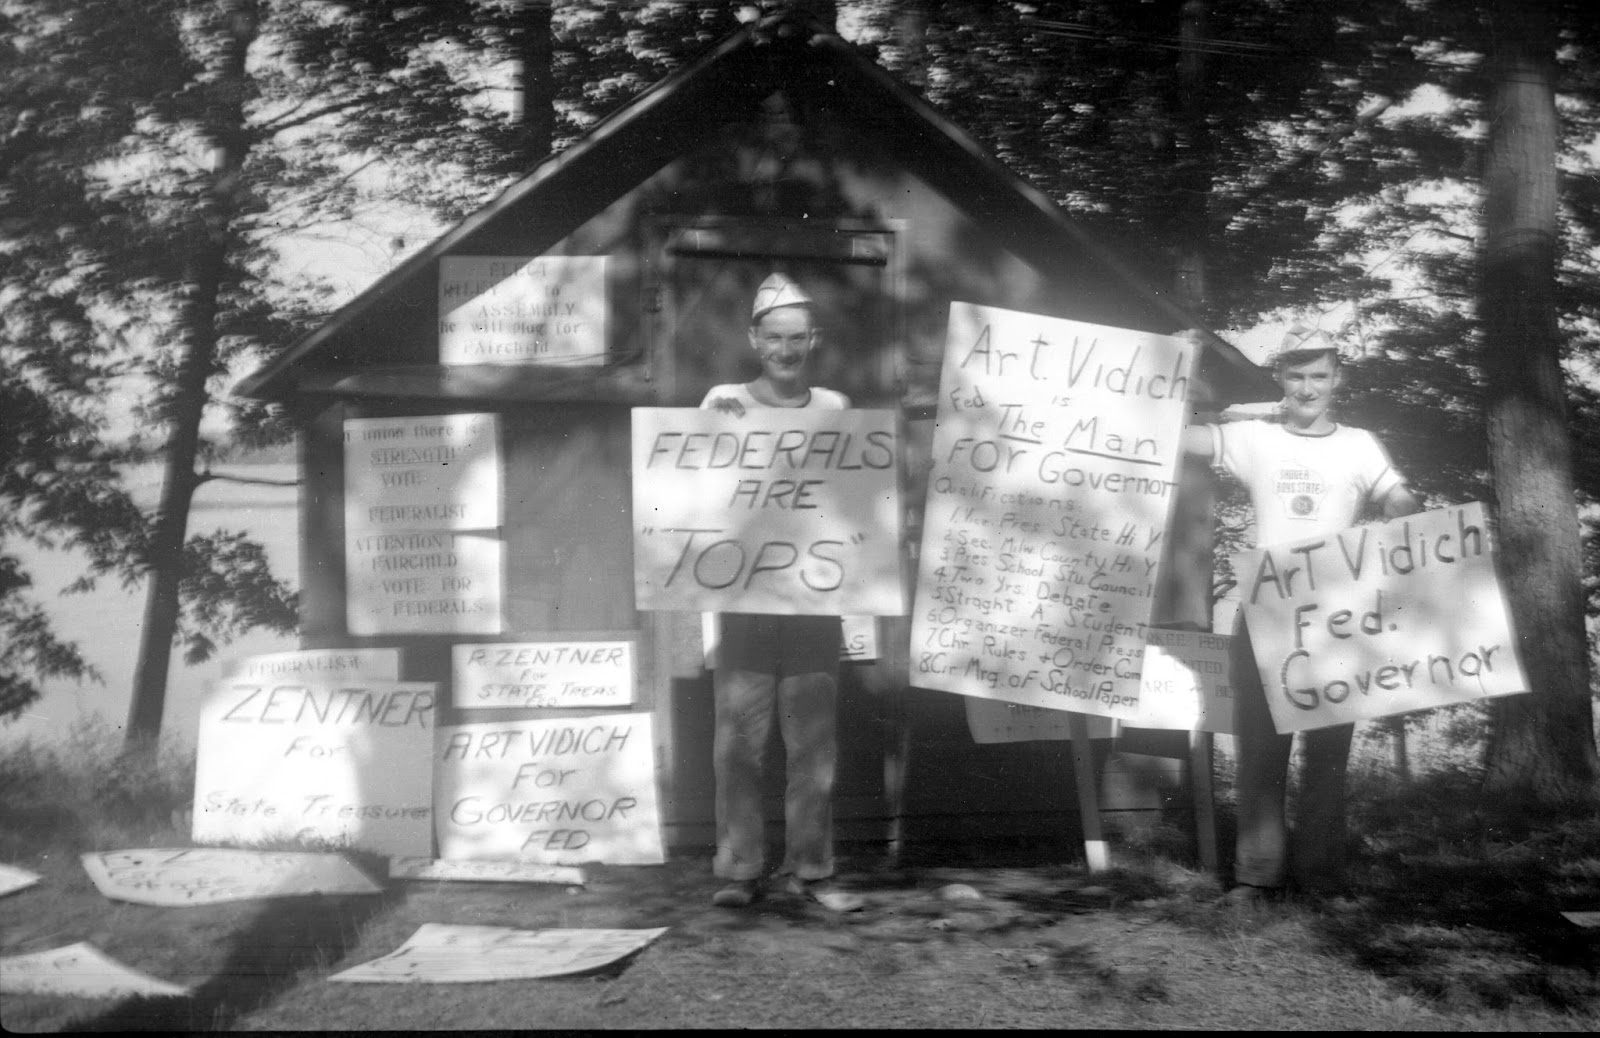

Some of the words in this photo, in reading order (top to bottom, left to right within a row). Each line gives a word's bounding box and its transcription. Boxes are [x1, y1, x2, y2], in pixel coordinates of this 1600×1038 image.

[1067, 335, 1188, 401] Vidich
[951, 384, 984, 409] Fed
[998, 403, 1046, 438] The
[1063, 415, 1158, 456] Man
[647, 430, 894, 471] FEDERALS
[380, 470, 423, 487] VOTE
[1038, 451, 1179, 499] Governor
[1297, 482, 1320, 495] STATE
[729, 479, 825, 510] ARE
[1052, 516, 1110, 541] State
[1115, 522, 1136, 546] Hi
[1144, 526, 1162, 552] Y
[1337, 508, 1483, 583] Vidich
[372, 553, 458, 571] FAIRCHILD
[954, 546, 989, 567] Pres
[995, 553, 1045, 578] School
[1040, 541, 1108, 574] County
[1145, 556, 1158, 577] Y
[382, 577, 426, 595] VOTE
[441, 576, 472, 592] FOR
[951, 565, 984, 585] Two
[1037, 581, 1111, 613] Debate
[939, 606, 1028, 636] Organizer
[1034, 623, 1092, 651] Federal
[1098, 634, 1143, 659] Press
[1064, 606, 1148, 639] Student
[1295, 588, 1398, 648] Fed.
[496, 647, 625, 668] ZENTNER
[982, 635, 1027, 661] Rules
[1053, 647, 1112, 676] Order
[477, 682, 550, 700] STATE
[1040, 668, 1096, 700] School
[1096, 680, 1139, 711] Paper
[1280, 643, 1501, 712] Governor
[221, 684, 434, 728] ZENTNER
[284, 735, 350, 759] For
[442, 728, 523, 761] ART
[529, 725, 633, 757] VIDICH
[205, 790, 277, 817] State
[450, 796, 637, 827] GOVERNOR
[520, 828, 591, 851] FED
